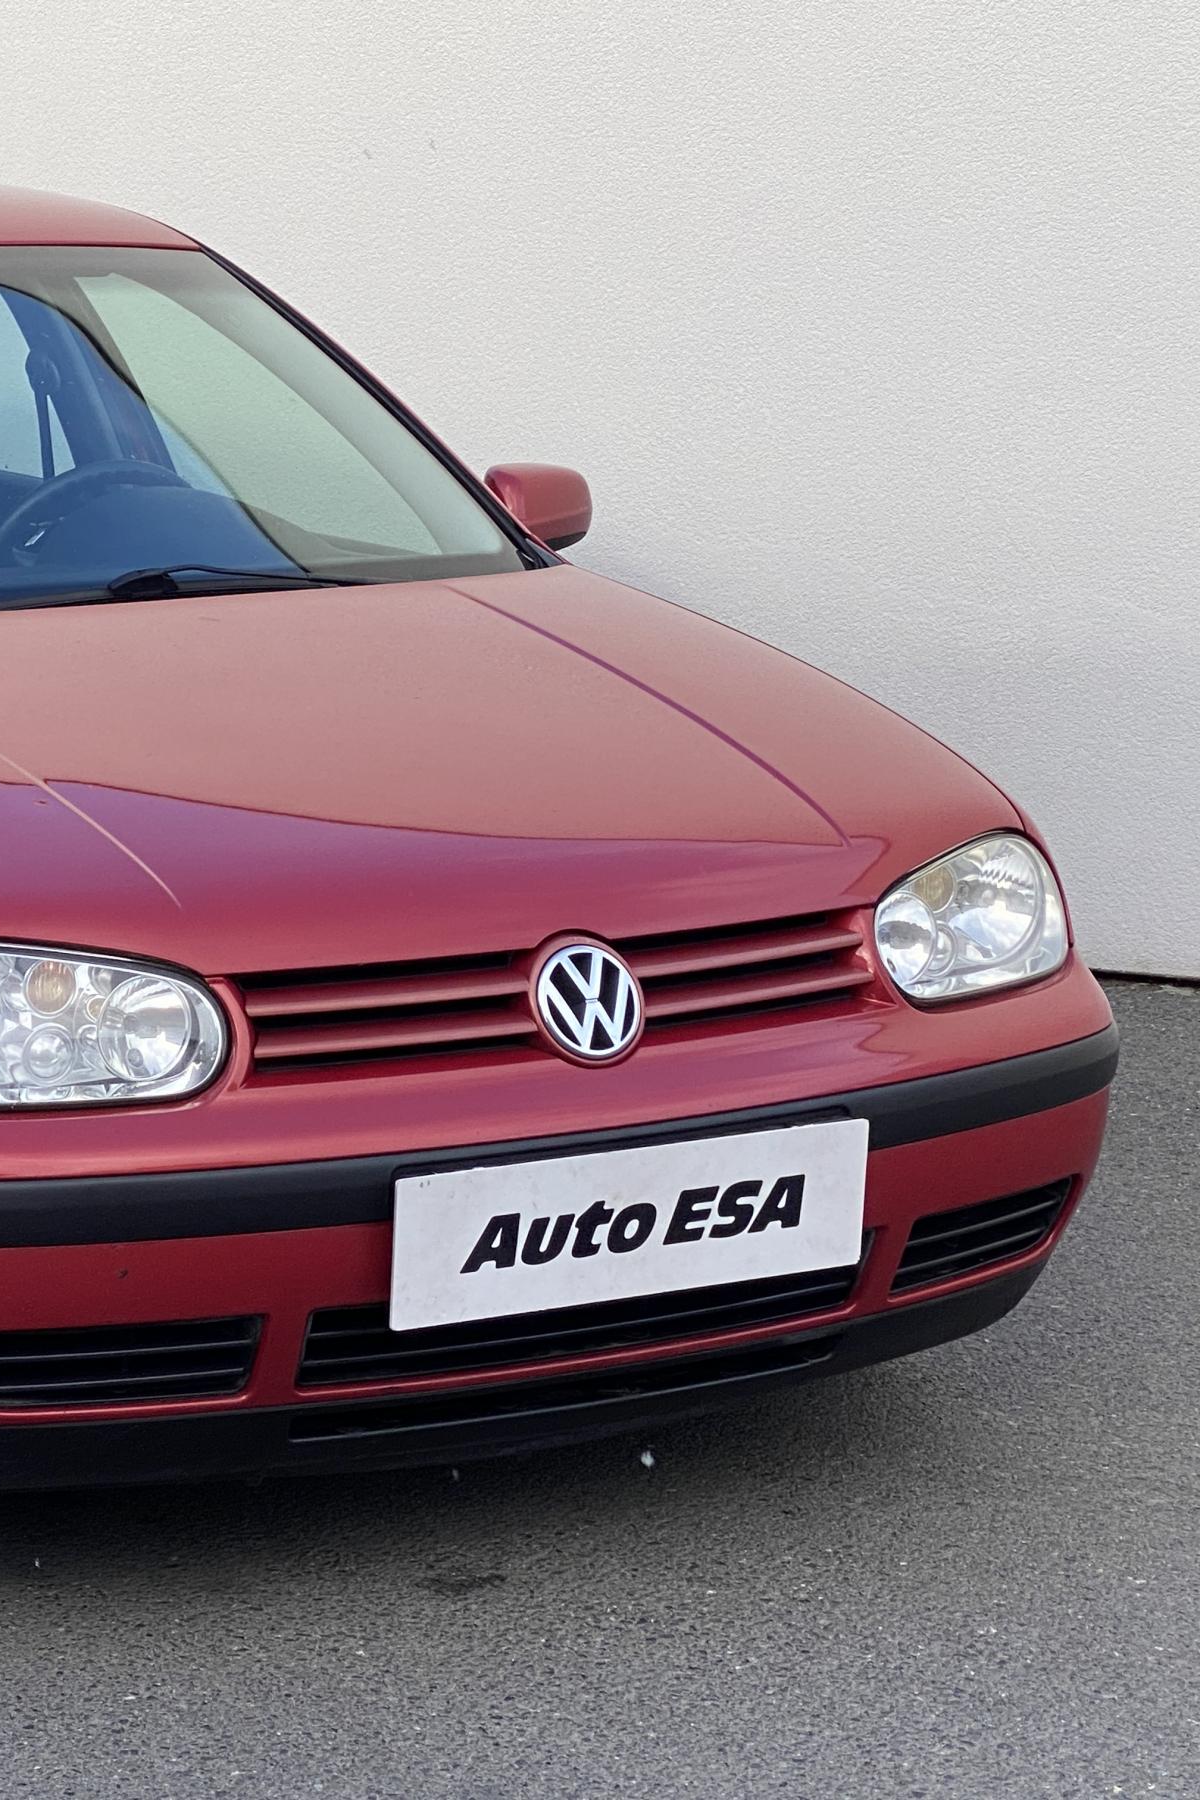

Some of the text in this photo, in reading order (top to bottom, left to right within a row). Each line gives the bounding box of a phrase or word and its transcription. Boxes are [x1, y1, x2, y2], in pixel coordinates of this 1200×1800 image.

[538, 945, 641, 1057] VW
[459, 1173, 806, 1274] Auto ESA
